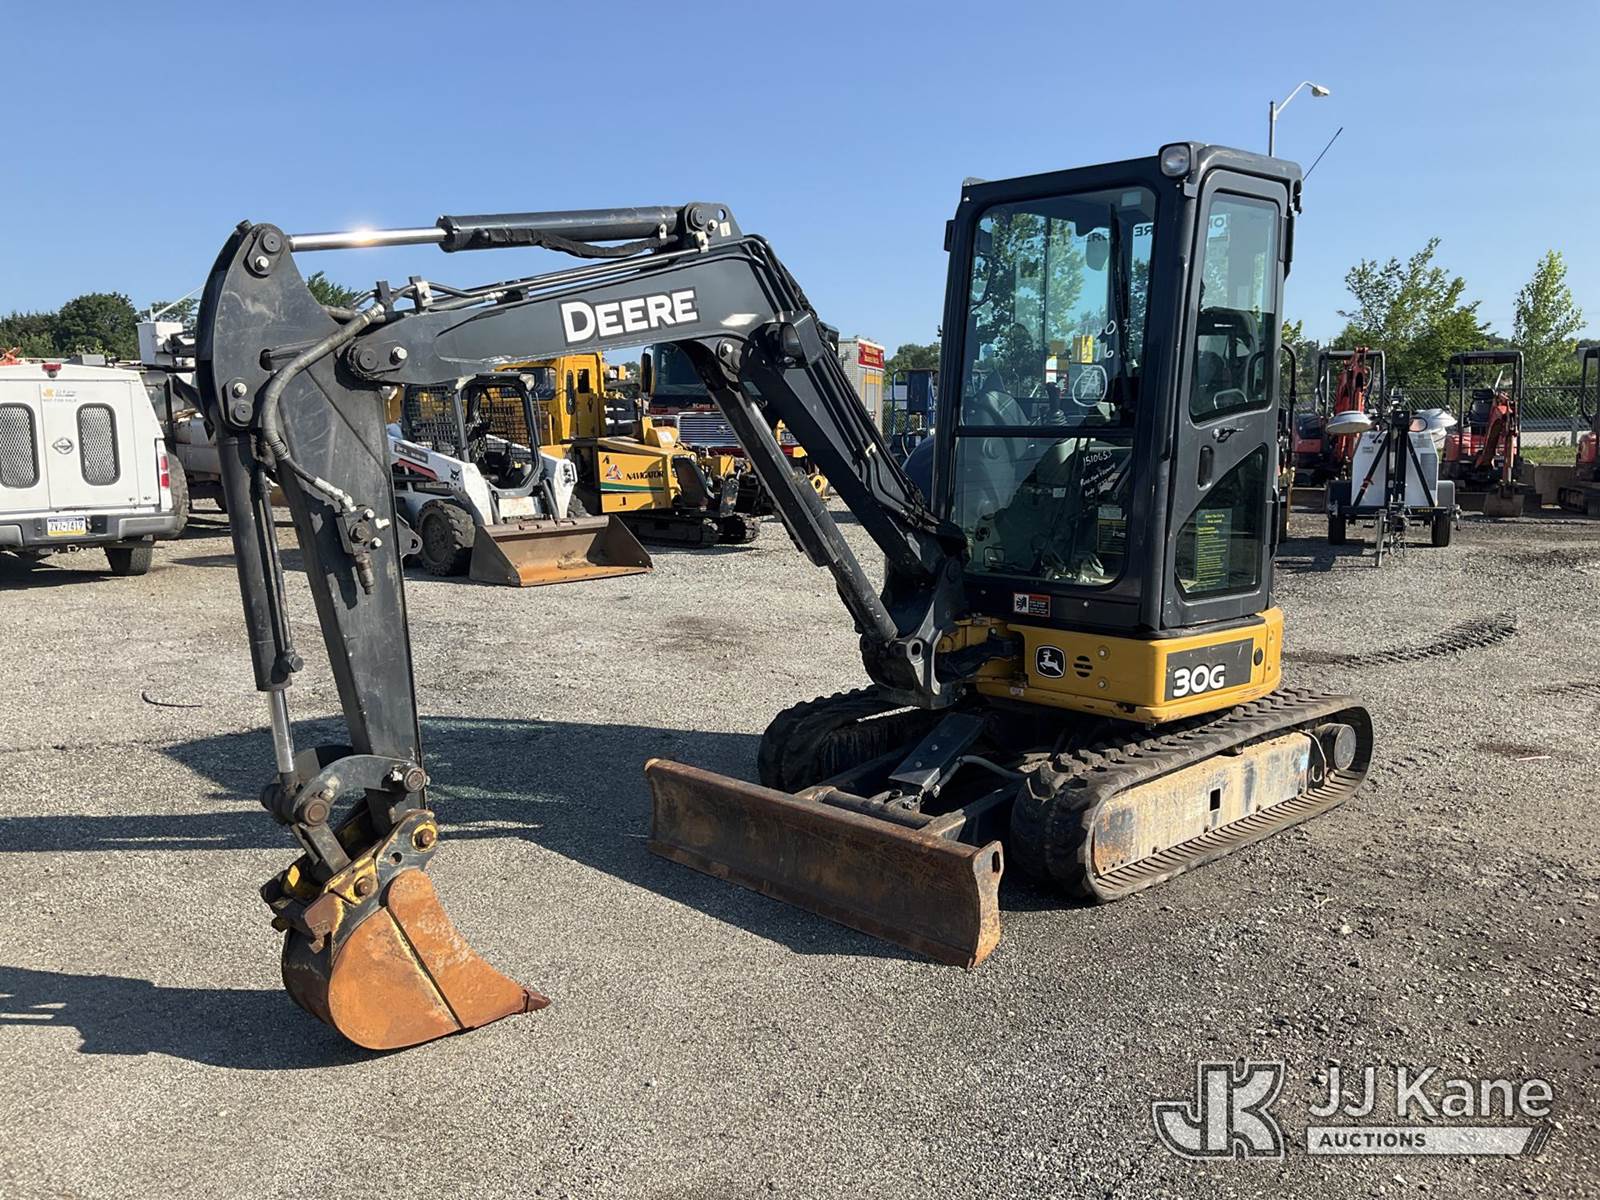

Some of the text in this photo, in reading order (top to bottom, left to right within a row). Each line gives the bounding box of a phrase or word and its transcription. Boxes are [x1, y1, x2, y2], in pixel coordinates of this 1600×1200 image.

[560, 290, 698, 343] DEERE
[625, 470, 665, 481] NAVIGATOR
[1172, 663, 1226, 698] 30G
